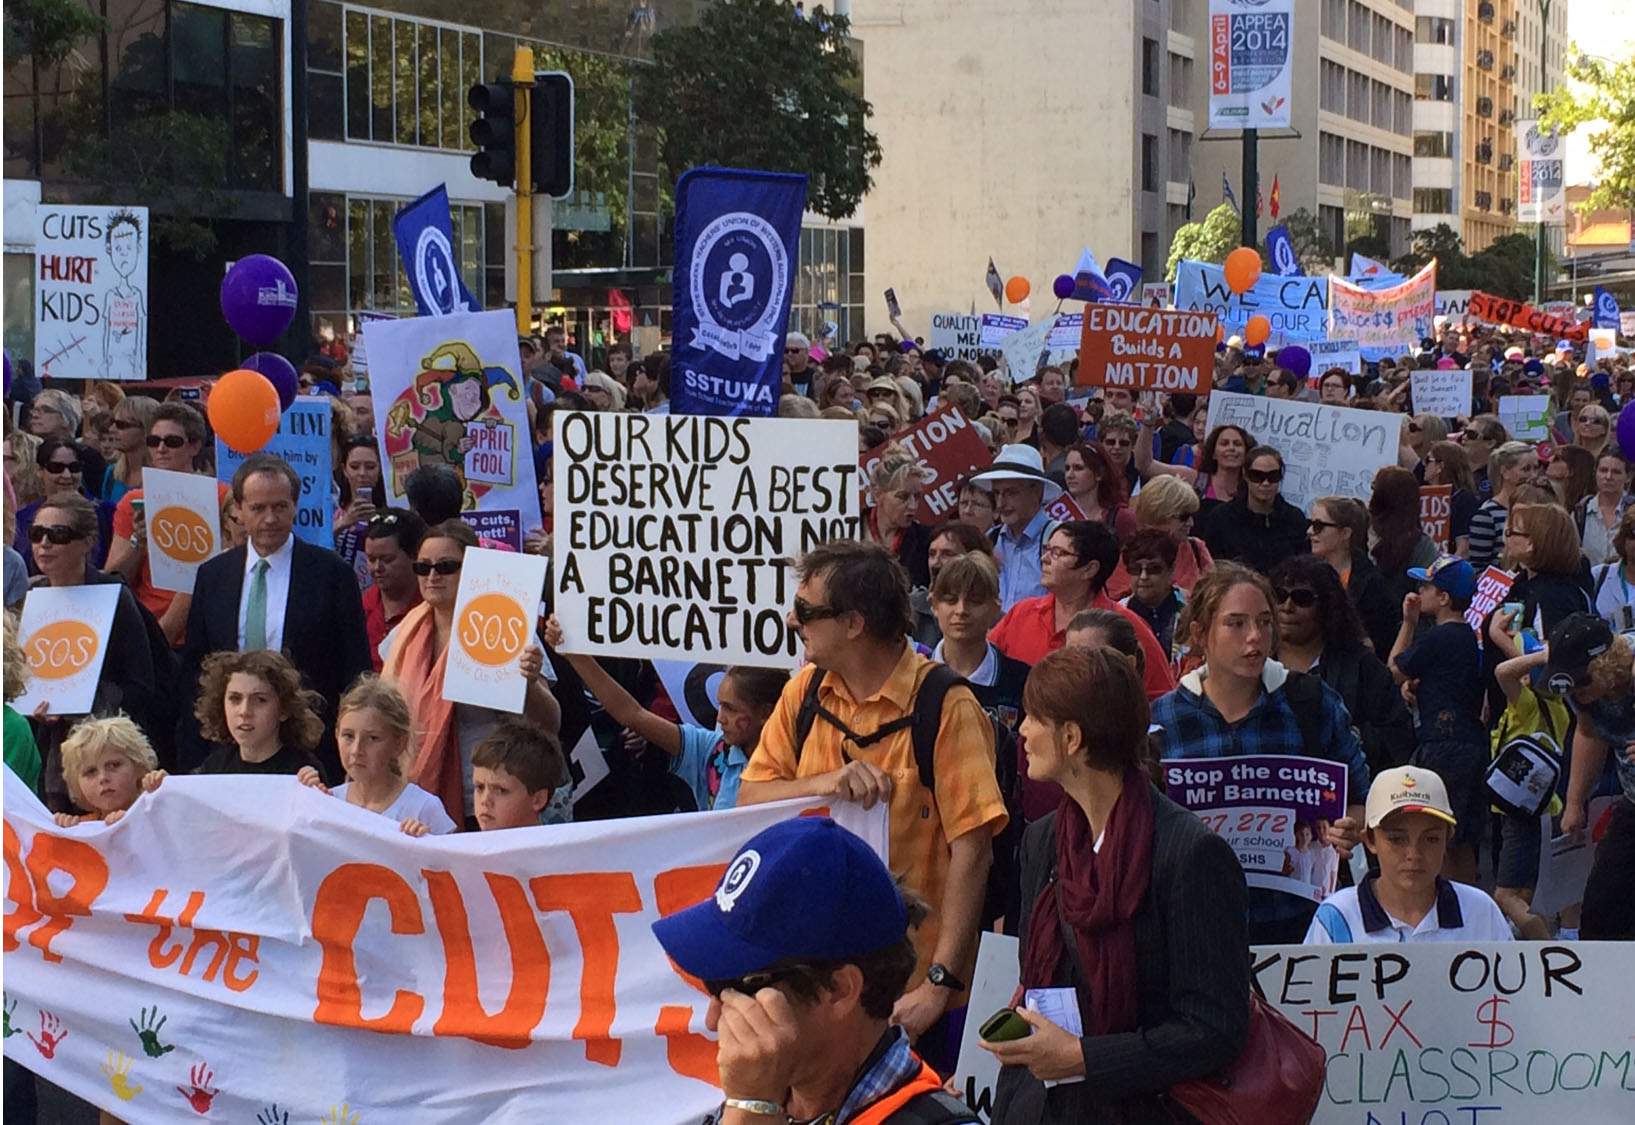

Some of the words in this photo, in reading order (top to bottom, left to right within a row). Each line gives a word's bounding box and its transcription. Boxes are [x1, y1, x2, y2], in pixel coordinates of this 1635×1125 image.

[1214, 16, 1227, 56] April
[1232, 14, 1286, 31] APPEA
[1232, 30, 1287, 51] 2014
[42, 213, 103, 240] CUTS
[40, 255, 97, 284] HURT
[41, 290, 100, 326] KIDS
[1270, 311, 1313, 332] OUR
[1470, 291, 1522, 324] STOP
[932, 314, 980, 331] QUALITY
[1090, 308, 1218, 338] EDUCATION
[1111, 334, 1165, 359] Builds
[1168, 342, 1183, 360] A
[1105, 362, 1198, 390] NATION
[561, 411, 653, 463] OUR
[665, 415, 752, 465] KIDS
[1216, 396, 1386, 455] Education
[469, 427, 511, 453] APRIL
[305, 451, 319, 466] by
[471, 451, 506, 476] FOOL
[566, 461, 718, 511] DESERVE
[732, 464, 759, 512] A
[768, 463, 857, 515] BEST
[480, 514, 515, 527] cuts,
[1419, 495, 1451, 518] IDS
[157, 518, 209, 555] SOS
[569, 509, 784, 556] EDUCATION
[800, 515, 860, 553] NOT
[560, 550, 585, 594] A
[608, 551, 795, 606] BARNETT
[462, 610, 524, 654] SOS
[27, 635, 94, 669] SOS
[1167, 766, 1224, 786] Stop
[1230, 763, 1271, 780] the
[1278, 765, 1337, 791] cuts,
[1185, 788, 1217, 805] Mr
[1224, 784, 1321, 806] Barnett!
[1243, 835, 1285, 849] school
[1239, 853, 1267, 865] SHS
[3, 817, 110, 964] OP
[123, 888, 260, 992] the
[1250, 950, 1411, 1005] KEEP
[1448, 945, 1583, 997] OUR
[1301, 999, 1423, 1053] TAX
[1468, 994, 1515, 1049] $
